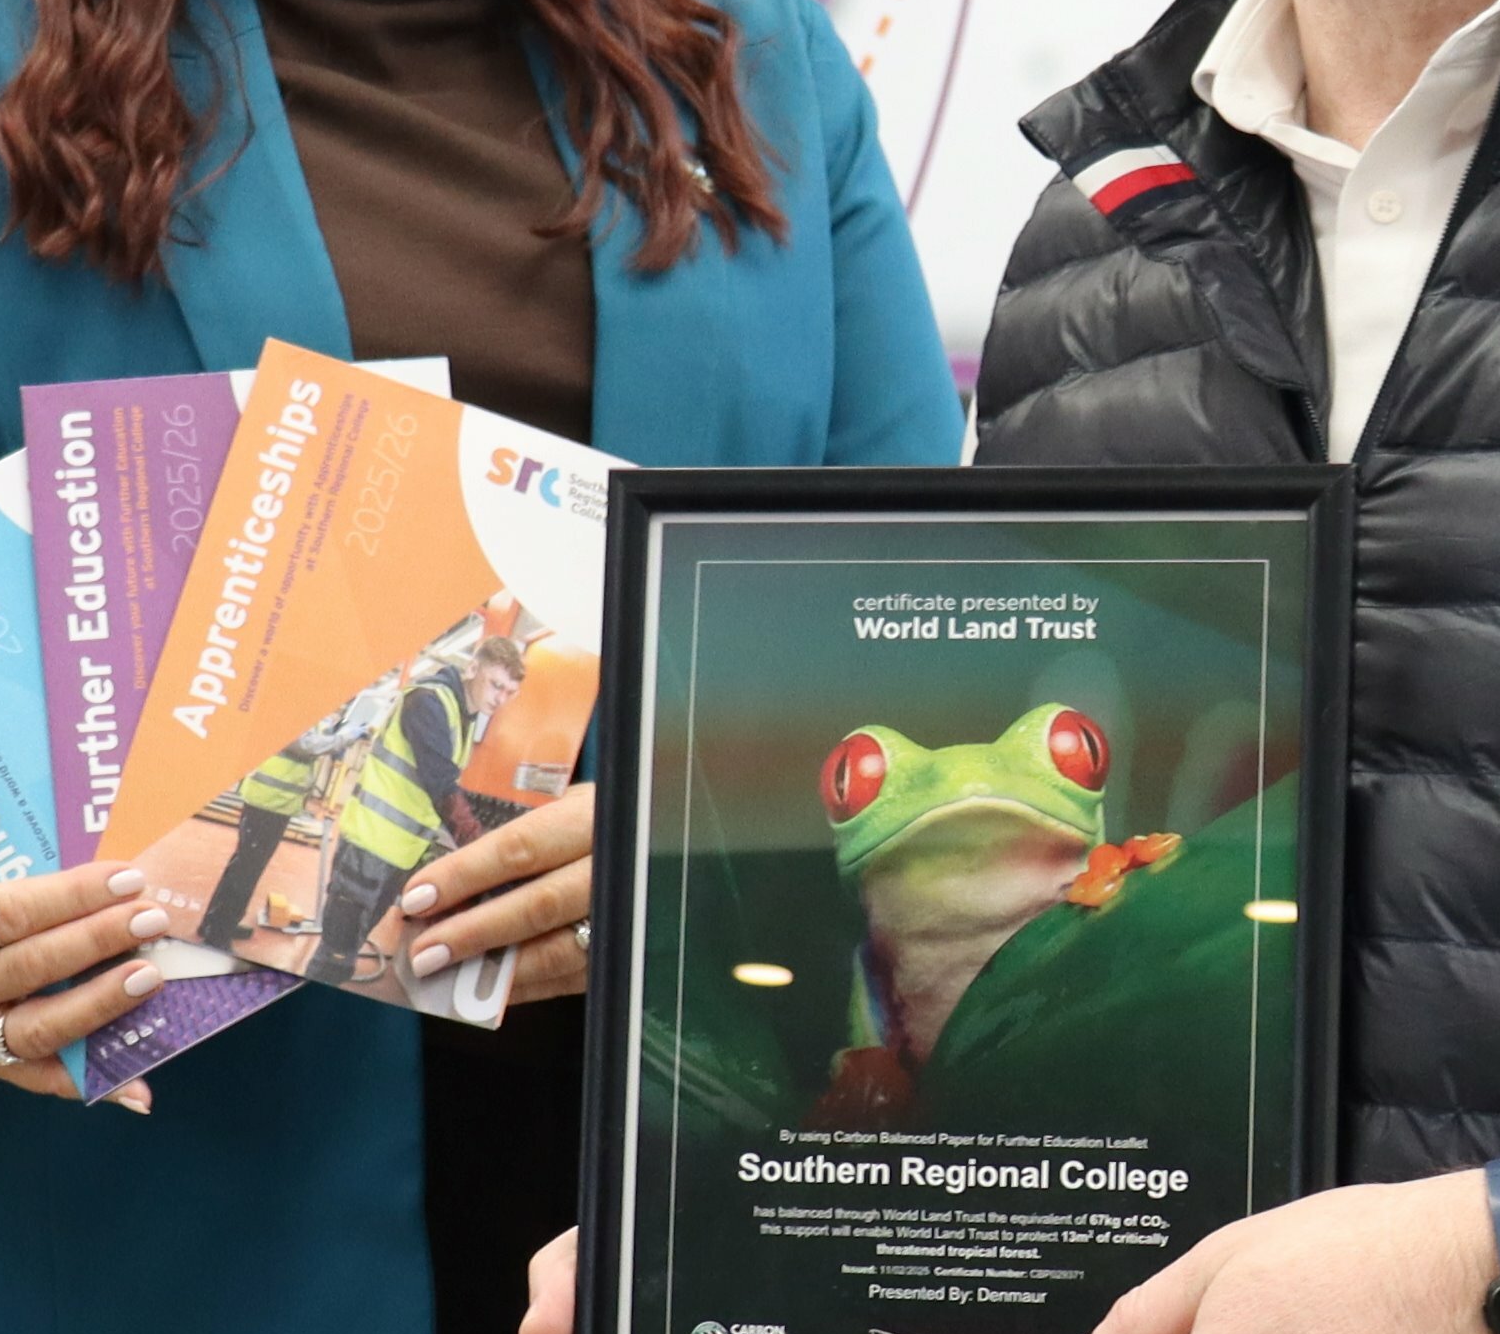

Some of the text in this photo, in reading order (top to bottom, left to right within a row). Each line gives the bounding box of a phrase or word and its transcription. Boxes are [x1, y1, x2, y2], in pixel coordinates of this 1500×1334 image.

[131, 405, 143, 451] College
[133, 455, 148, 509] Regional
[162, 404, 203, 553] 2025/26
[345, 413, 418, 556] 2025/26
[485, 448, 561, 508] src
[113, 407, 148, 689] Discover your future with Further Education
[139, 512, 152, 572] Southern
[172, 378, 322, 739] Apprenticeships
[55, 411, 121, 833] Further Education
[852, 593, 1099, 615] certificate presented by
[854, 616, 1097, 640] World Land Trust
[22, 811, 58, 860] Discover
[779, 1129, 1148, 1149] By using Carbon Balanced Paper for Further Education Leaflet
[738, 1153, 1188, 1199] Southern Regional College
[753, 1205, 776, 1217] has
[778, 1206, 833, 1219] balanced
[835, 1208, 880, 1222] through
[882, 1209, 919, 1221] World
[921, 1210, 952, 1222] Land
[954, 1210, 986, 1222] Trust
[988, 1211, 1007, 1224] the
[1010, 1212, 1072, 1226] equivalent
[760, 1223, 782, 1235] this
[784, 1224, 830, 1238] support
[831, 1225, 850, 1236] will
[852, 1226, 894, 1238] enable
[896, 1227, 932, 1239] World
[934, 1228, 965, 1240] Land
[968, 1228, 1000, 1241] Trust
[1015, 1230, 1059, 1244] protect
[1112, 1232, 1169, 1247] critically
[876, 1243, 1041, 1259] threatened tropical forest.
[868, 1283, 1048, 1304] Presented By: Denmaur
